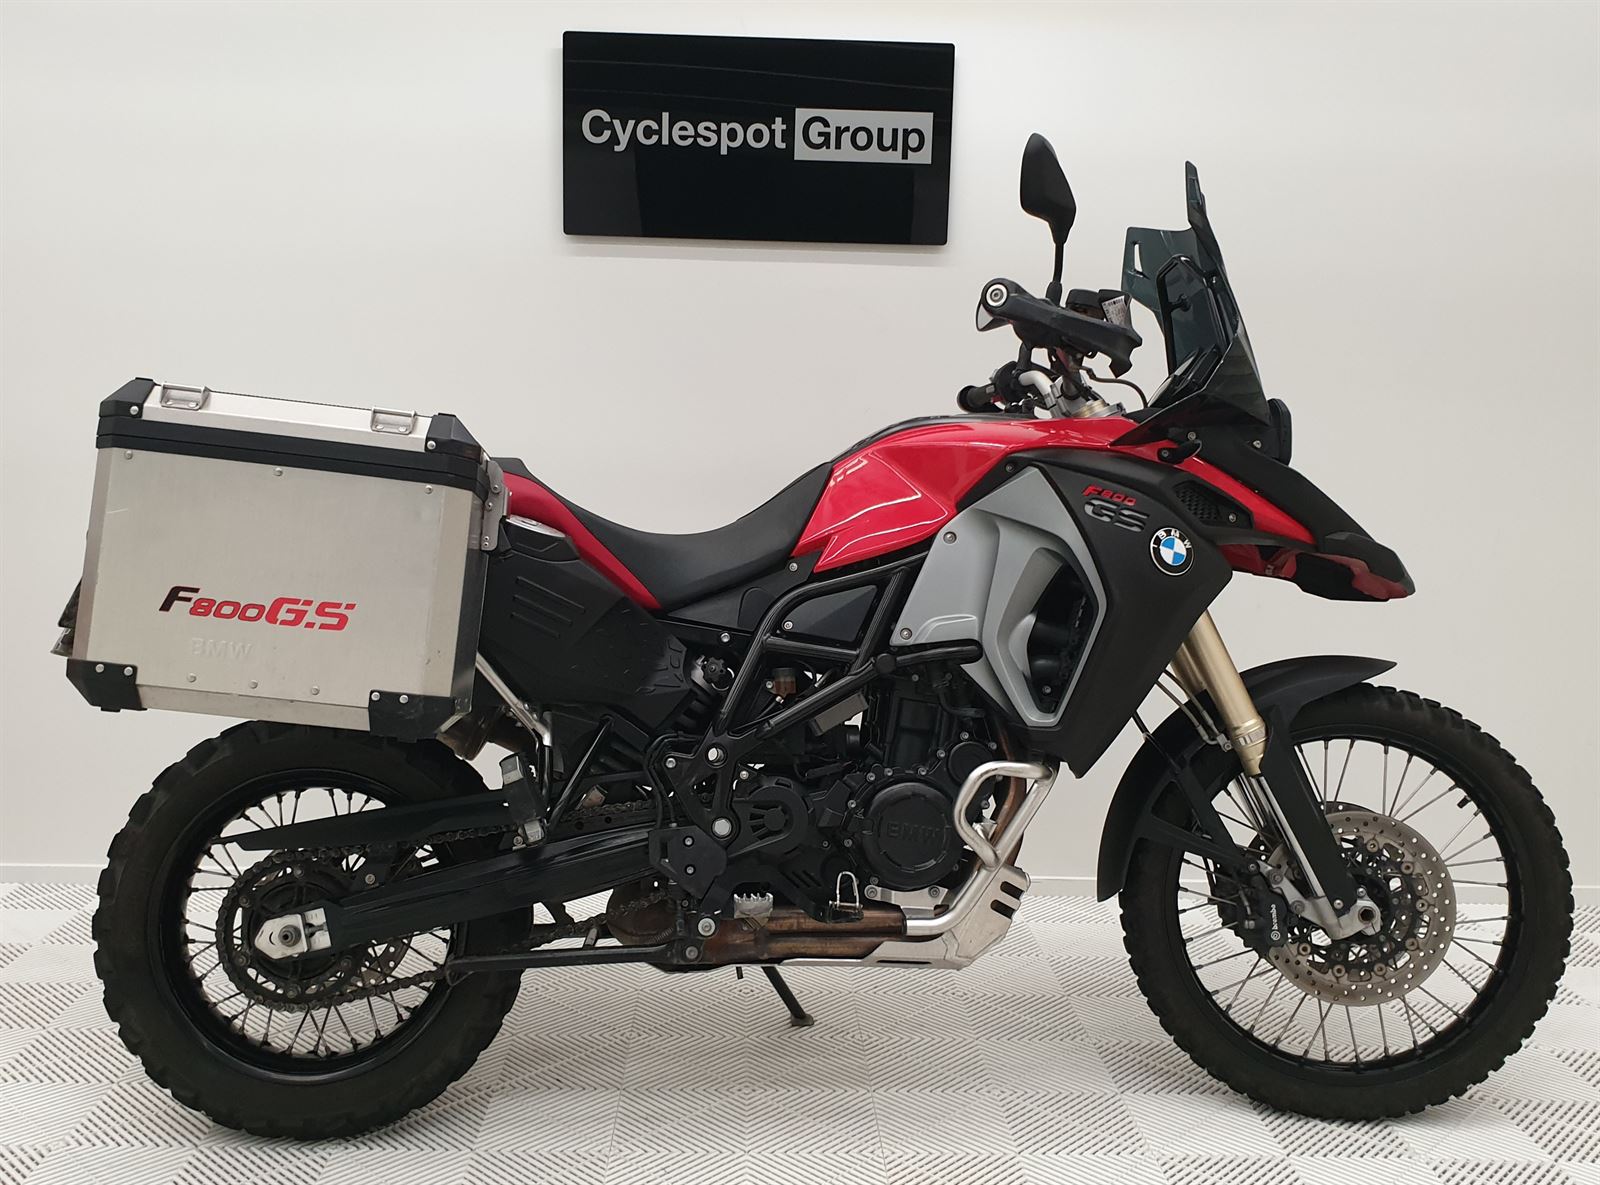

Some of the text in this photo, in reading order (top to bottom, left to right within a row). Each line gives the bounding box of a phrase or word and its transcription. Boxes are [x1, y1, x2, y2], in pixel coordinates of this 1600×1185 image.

[581, 109, 926, 160] Cyclespot Group
[1082, 485, 1137, 506] F800
[1084, 498, 1149, 532] GS
[1156, 528, 1192, 549] BMW
[191, 637, 254, 660] BMW
